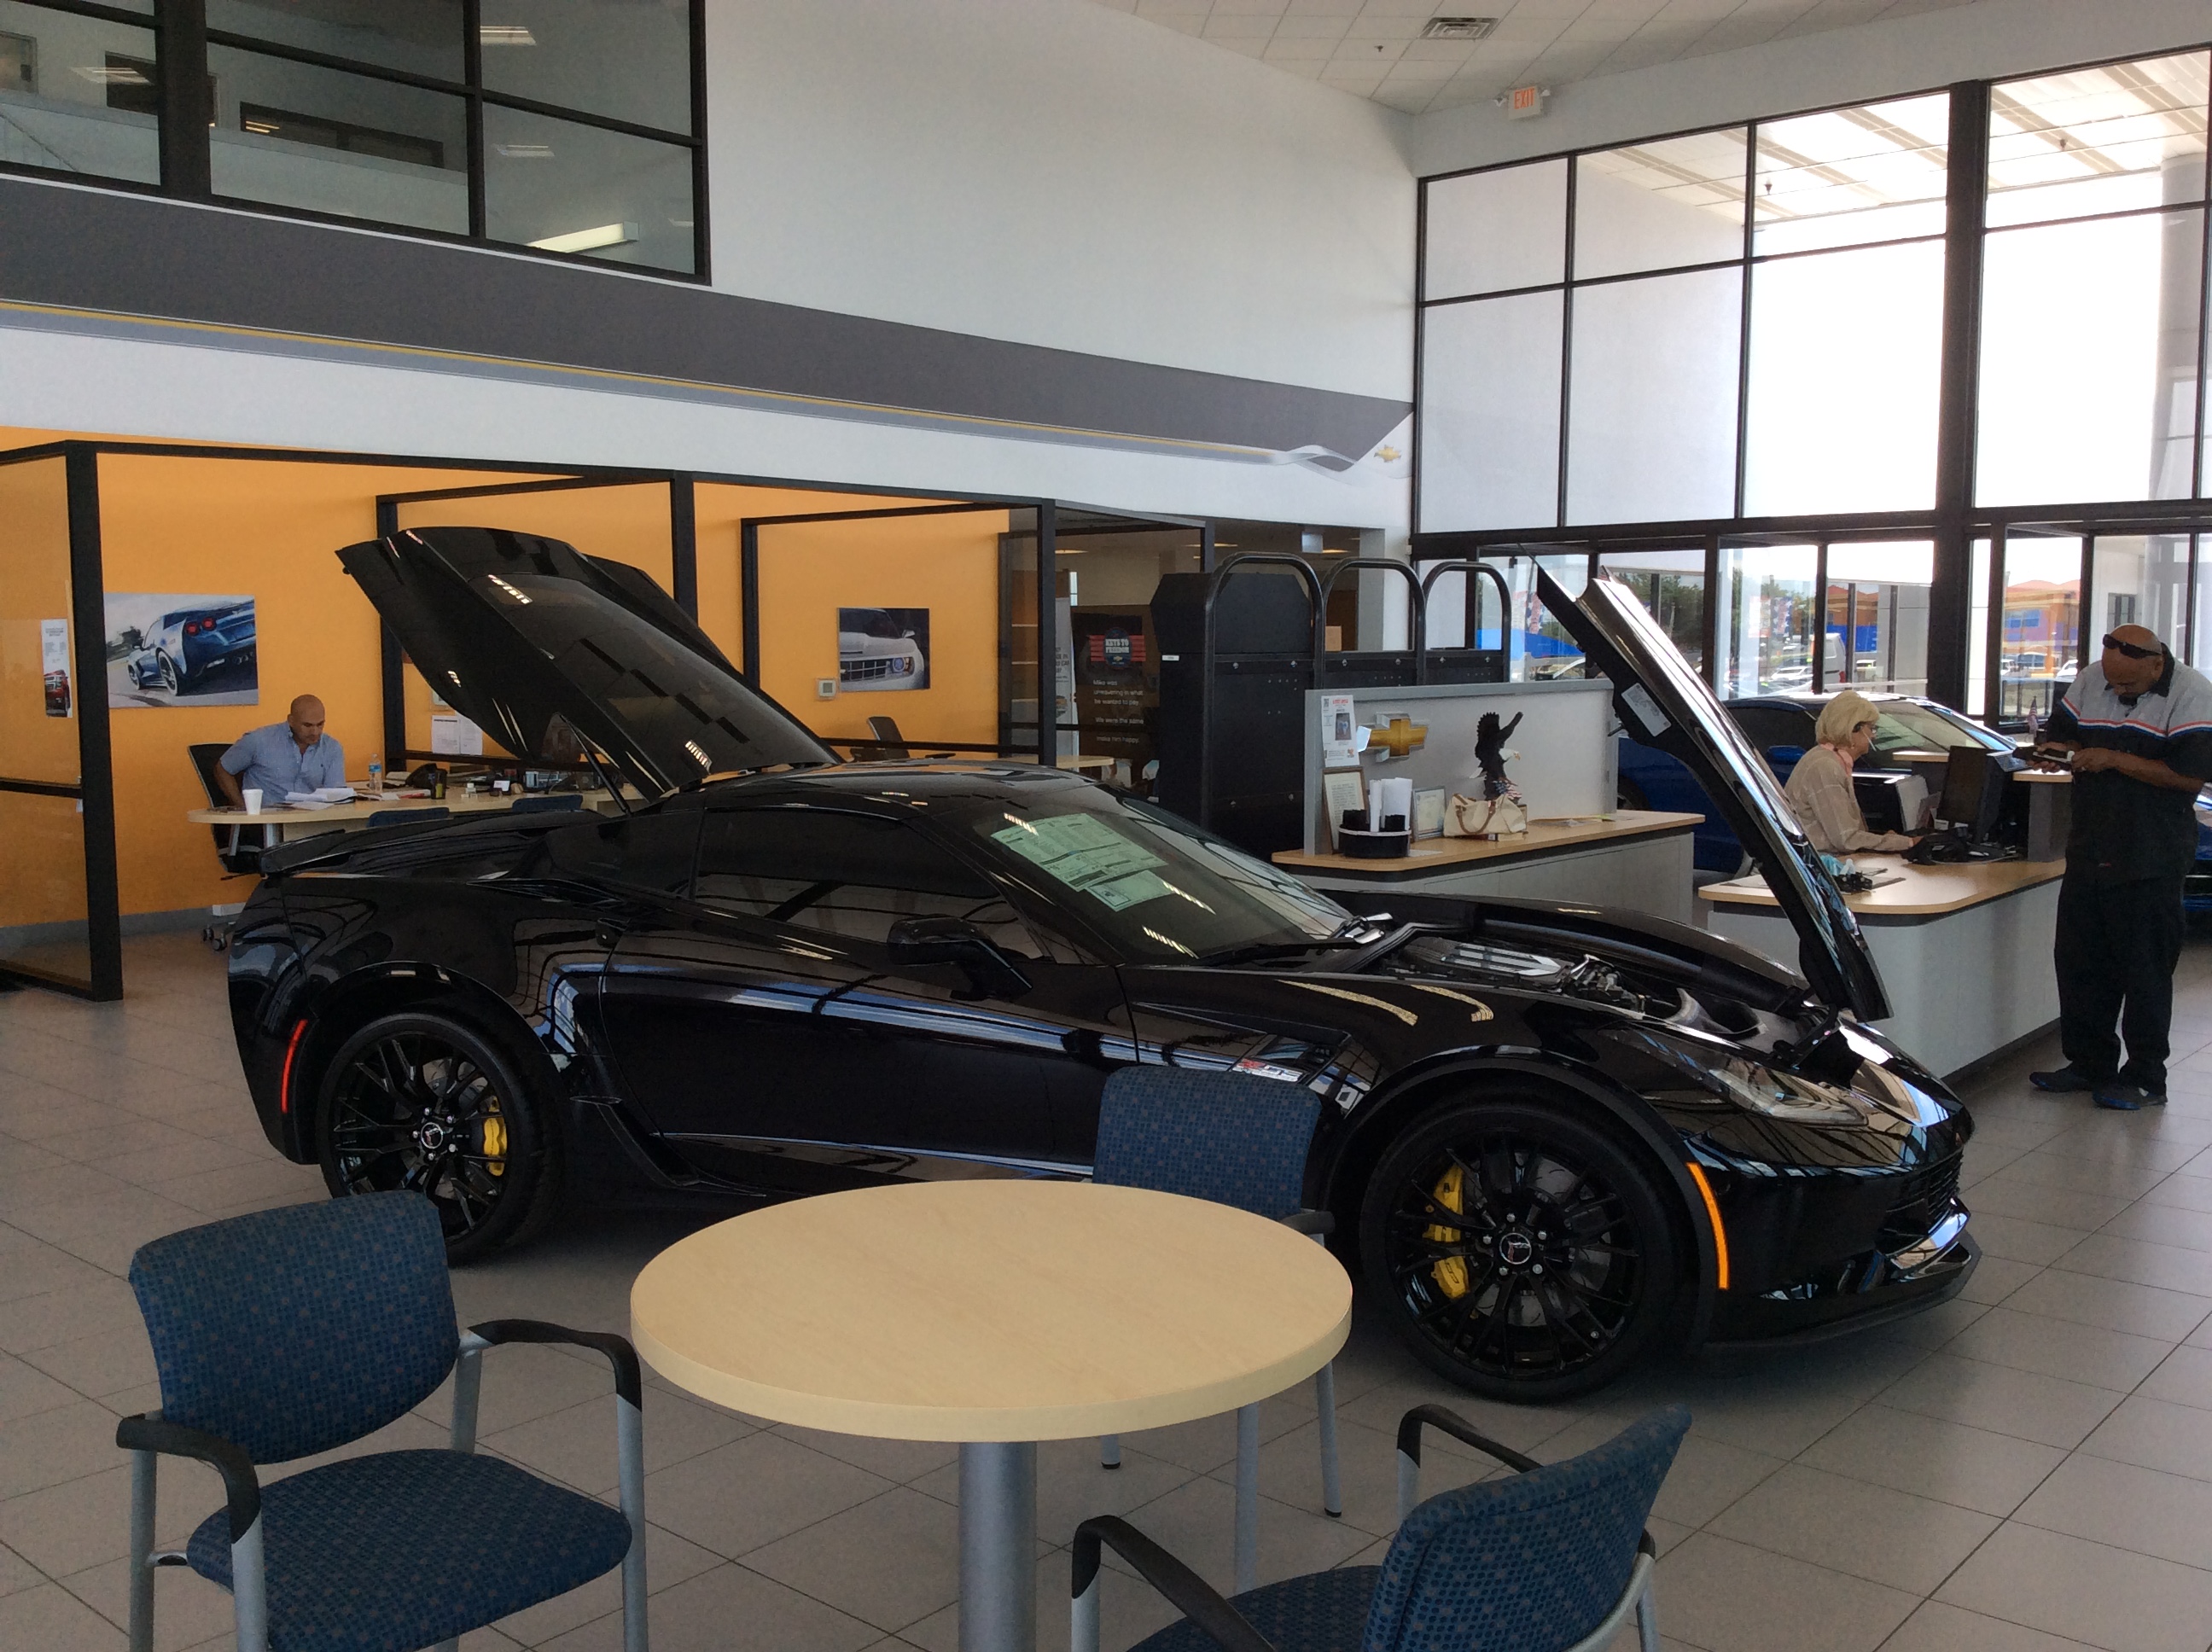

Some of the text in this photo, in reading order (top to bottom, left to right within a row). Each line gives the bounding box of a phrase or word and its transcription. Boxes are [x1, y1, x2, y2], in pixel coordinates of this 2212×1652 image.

[1514, 86, 1535, 109] EXIT
[1105, 638, 1129, 647] KEYS TO
